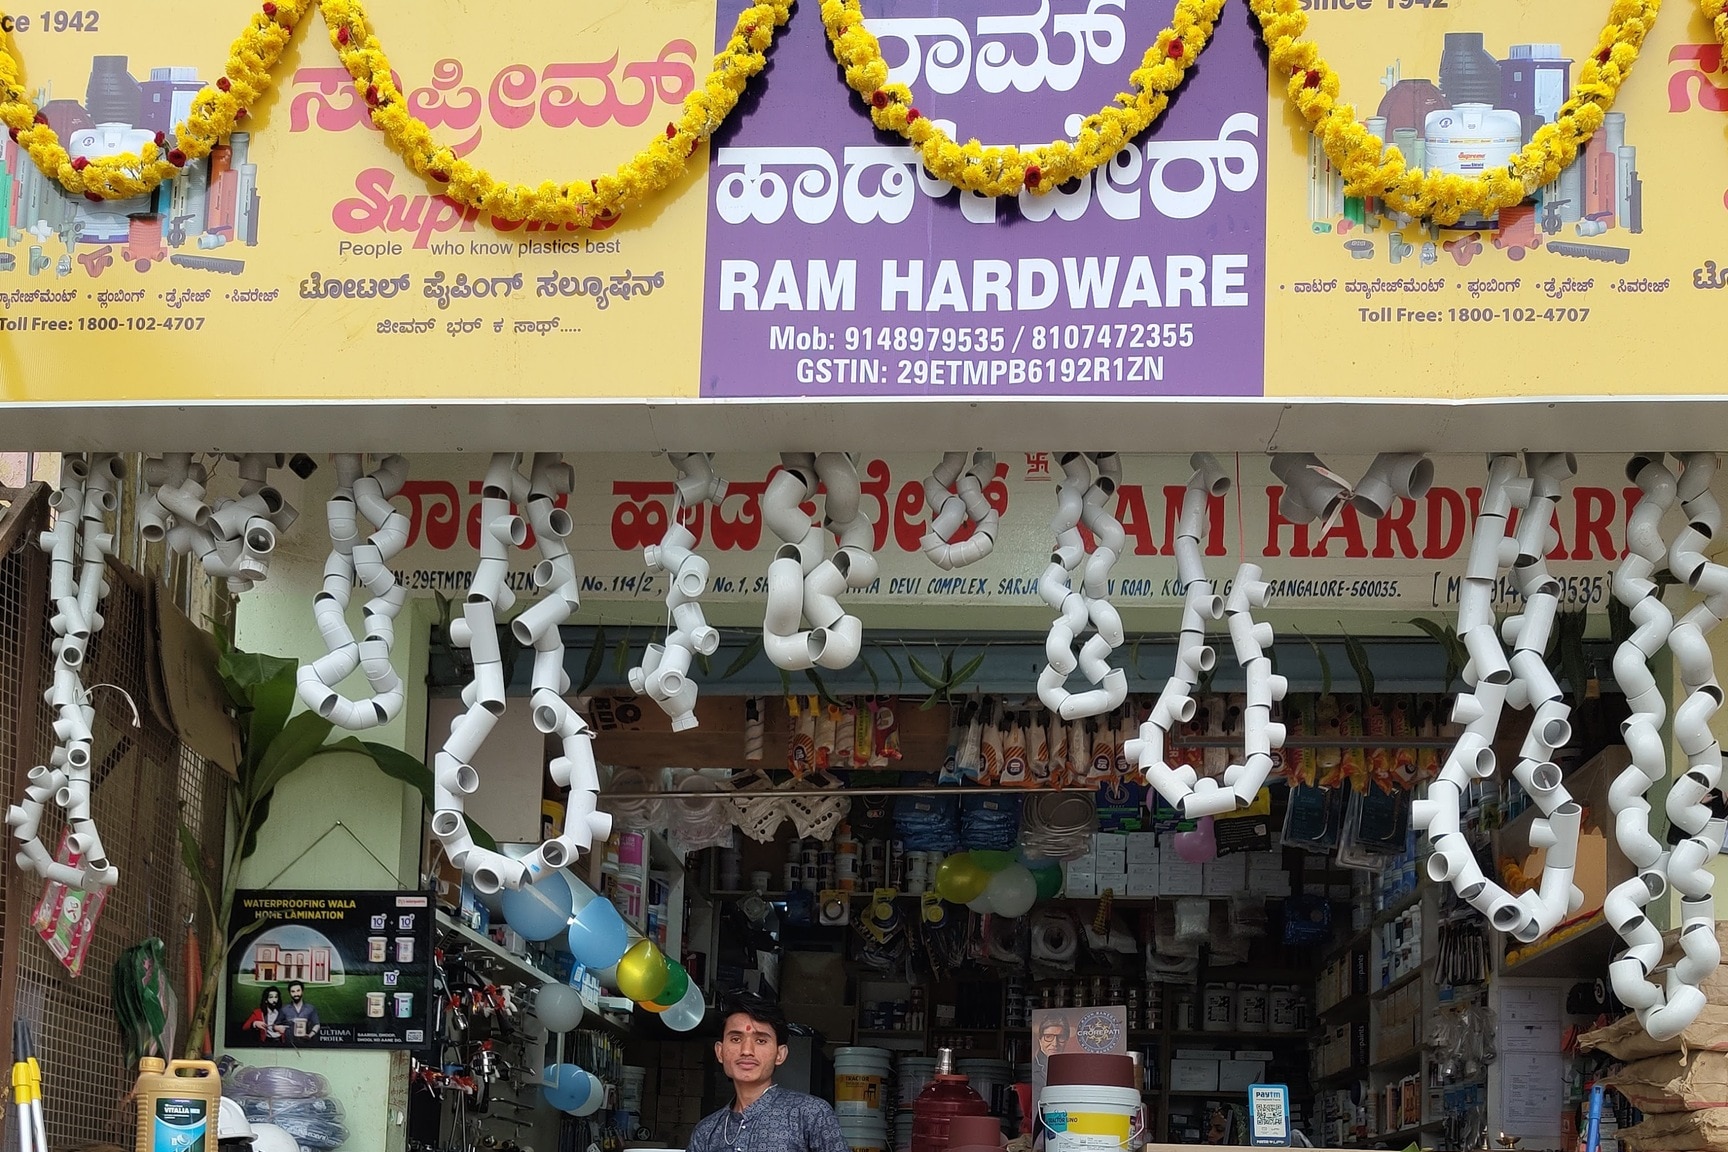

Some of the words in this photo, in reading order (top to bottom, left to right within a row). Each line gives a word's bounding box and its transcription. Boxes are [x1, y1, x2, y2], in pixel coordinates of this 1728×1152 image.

[40, 10, 100, 32] 1942
[339, 241, 402, 257] People
[431, 241, 465, 255] who
[470, 240, 514, 255] know
[518, 239, 580, 258] plastics
[585, 239, 621, 254] best
[299, 271, 411, 300] ಟೋಟಲ್
[423, 270, 523, 309] ಪೈಪಿಂಗ್
[719, 258, 856, 311] RAM
[881, 254, 1249, 312] HARDWARE
[1294, 279, 1337, 293] ವಾಟರ್
[0, 318, 27, 330] Toll
[32, 318, 73, 330] Free:
[78, 317, 205, 330] 1800-102-4707
[1358, 308, 1391, 322] Toll
[1397, 308, 1442, 322] Free:
[1448, 308, 1590, 322] 1800-102-4707
[376, 317, 436, 334] ಜೀವನ್
[446, 318, 482, 337] ಭರ್
[769, 325, 835, 351] Mob:
[844, 326, 1005, 352] 9148979535
[1011, 325, 1025, 352] /
[1032, 323, 1193, 350] 8107472355
[797, 358, 888, 384] GSTIN:
[897, 356, 1164, 385] 29ETMPB6192R1ZN
[889, 578, 921, 594] DEVI
[927, 578, 992, 598] COMPLEX,
[1121, 579, 1154, 597] ROAD,
[243, 899, 325, 908] WATERPROOFING
[328, 899, 356, 909] WALA
[255, 910, 282, 919] HOME
[285, 910, 344, 920] LAMINATION
